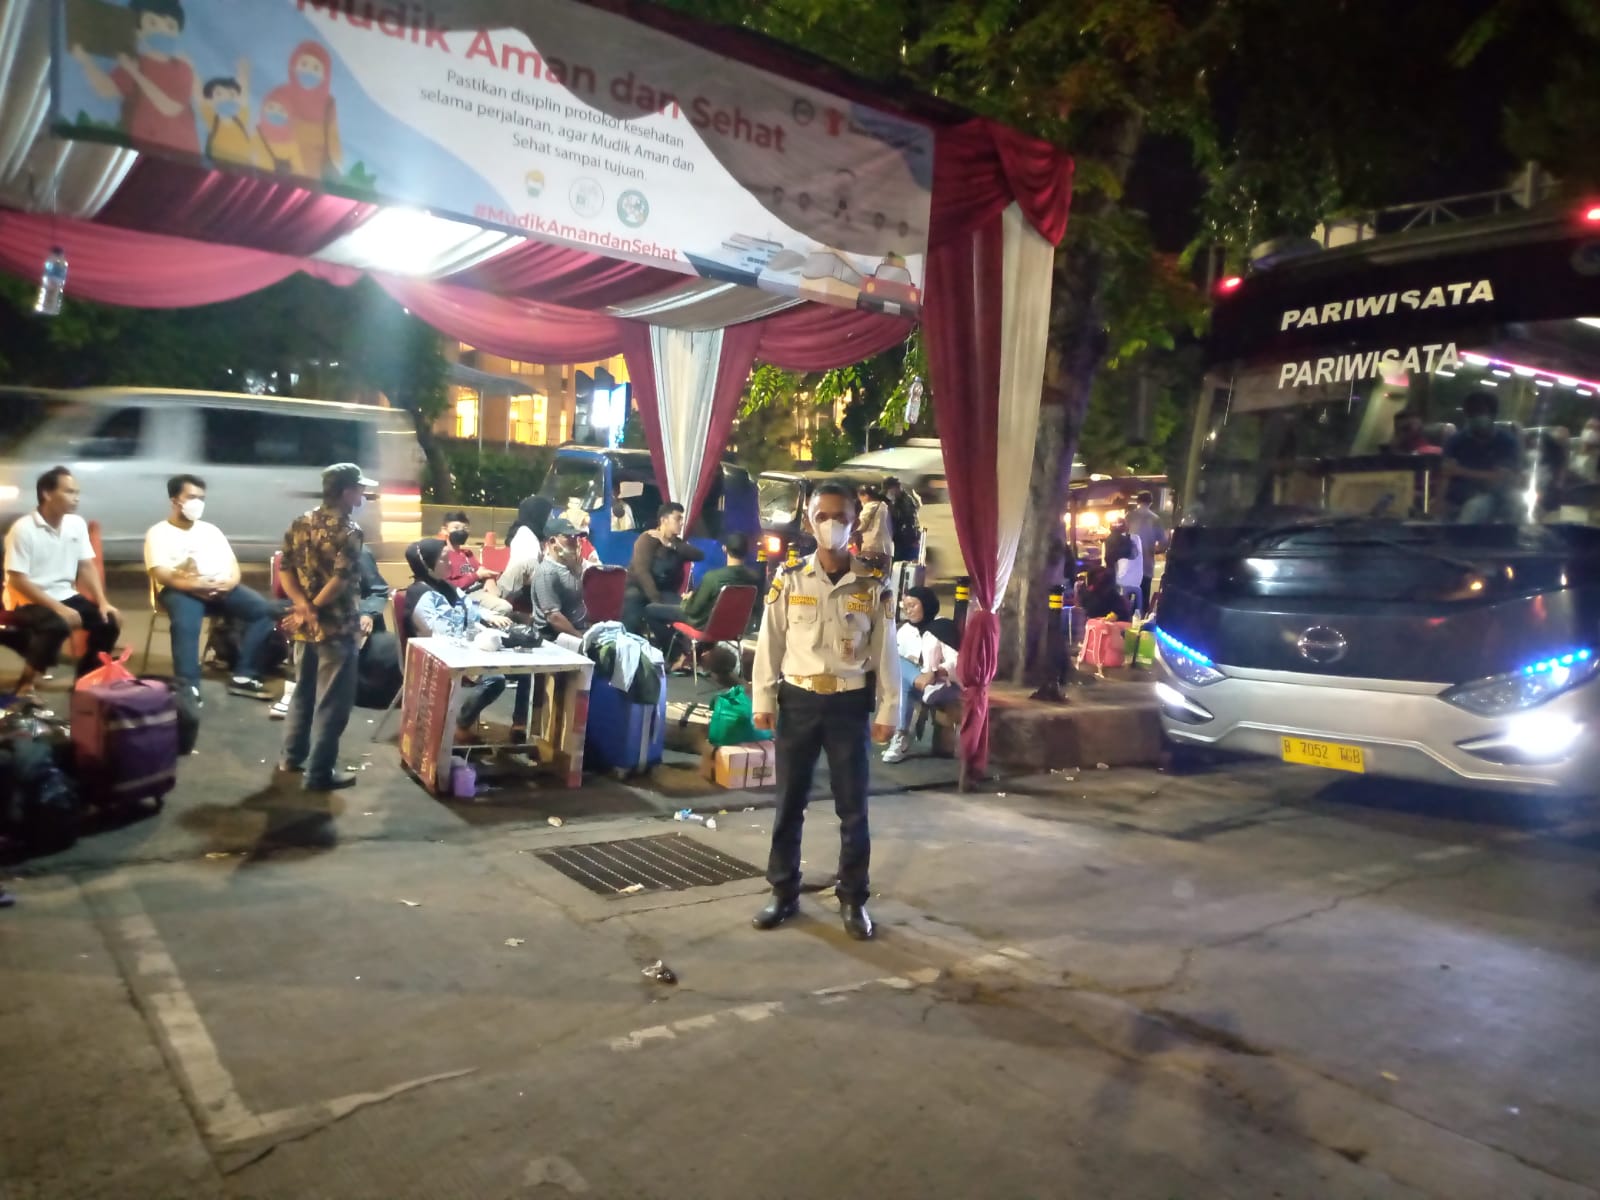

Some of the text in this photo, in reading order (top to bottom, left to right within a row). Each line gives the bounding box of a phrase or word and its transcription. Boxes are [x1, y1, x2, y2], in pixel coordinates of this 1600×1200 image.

[447, 69, 685, 149] Pastikan disiplin protokol kesehatan
[465, 29, 596, 93] Aman
[610, 71, 680, 119] dan
[691, 102, 786, 154] Sehat
[420, 87, 695, 173] selama perjalanan, agar Mudik Aman dan
[512, 132, 552, 156] Sehat
[554, 142, 602, 170] sampai
[473, 202, 678, 262] #MudikAmandanSehat
[1280, 279, 1495, 331] PARIWISATA
